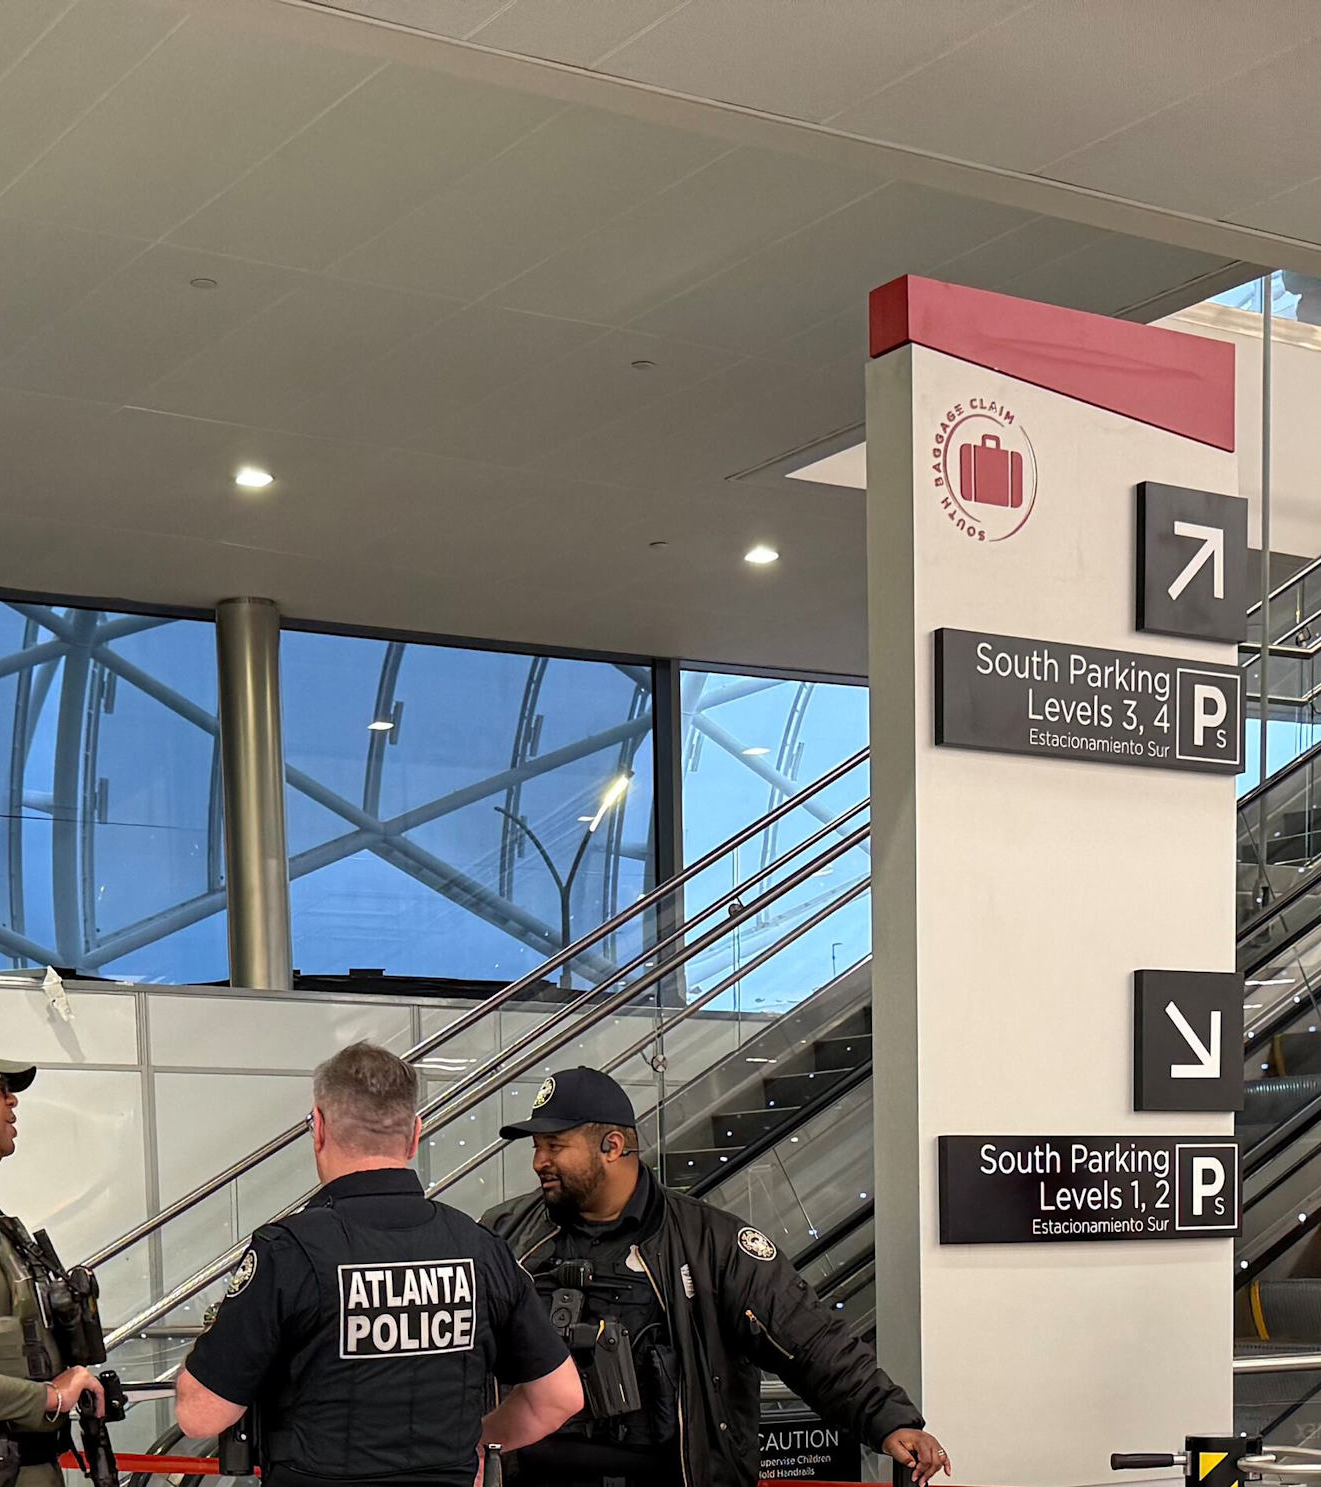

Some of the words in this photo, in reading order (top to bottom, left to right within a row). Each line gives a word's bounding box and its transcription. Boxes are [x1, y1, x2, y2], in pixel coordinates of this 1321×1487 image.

[969, 398, 1015, 425] CLAIM
[932, 404, 964, 487] BAGGAGE
[941, 497, 986, 541] SOUTH
[976, 642, 1059, 682] South
[1069, 654, 1170, 701] Parking
[1028, 688, 1113, 728] Levels
[1122, 700, 1144, 735] 3,
[1153, 704, 1170, 733] 4
[1029, 728, 1144, 756] Estacionamiento
[1147, 741, 1170, 758] Sur
[980, 1143, 1061, 1175] South
[1071, 1143, 1170, 1178] Parking
[1040, 1180, 1123, 1211] Levels
[1130, 1180, 1146, 1213] 1,
[1155, 1180, 1170, 1209] 2
[1032, 1217, 1144, 1235] Estacionamiento
[1147, 1216, 1170, 1232] Sur
[347, 1266, 472, 1310] ATLANTA
[347, 1309, 472, 1352] POLICE
[760, 1456, 796, 1468] upervise
[797, 1454, 831, 1465] Children
[776, 1467, 815, 1478] Handrails
